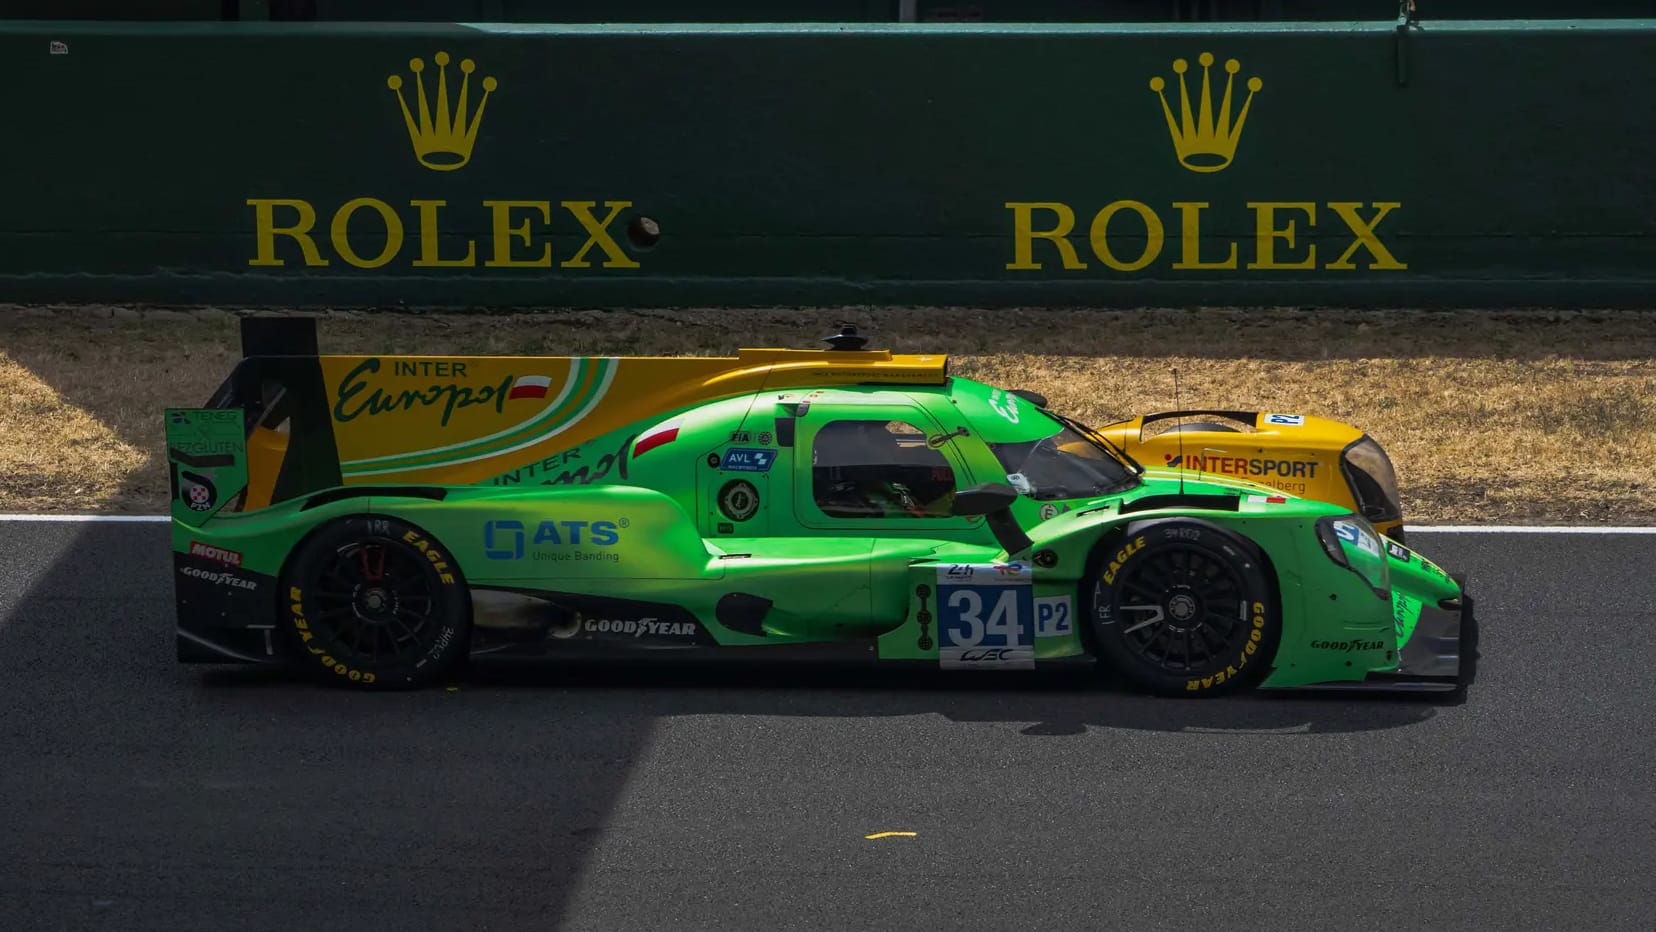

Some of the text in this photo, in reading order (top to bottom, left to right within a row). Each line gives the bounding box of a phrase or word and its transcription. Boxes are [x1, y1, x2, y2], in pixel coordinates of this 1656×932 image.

[246, 197, 641, 269] ROLEX
[1005, 199, 1408, 271] ROLEX
[395, 361, 467, 377] INTER
[334, 358, 513, 427] Europol
[1271, 414, 1299, 424] P2
[494, 447, 581, 485] INTER
[728, 453, 751, 464] AVL
[1186, 455, 1319, 479] INTERSPORT
[191, 543, 241, 565] MOTUL
[402, 529, 456, 585] EAGLE
[532, 551, 620, 563] Unique Banding
[1103, 535, 1147, 585] EAGLE
[183, 566, 257, 591] GOODYEAR
[584, 617, 696, 638] GOODYEAR
[947, 589, 1024, 647] 34
[1038, 602, 1069, 633] P2
[288, 585, 376, 684] GOODYEAR
[1184, 600, 1265, 692] GOODYEAR
[1310, 639, 1384, 653] GOODYEAR
